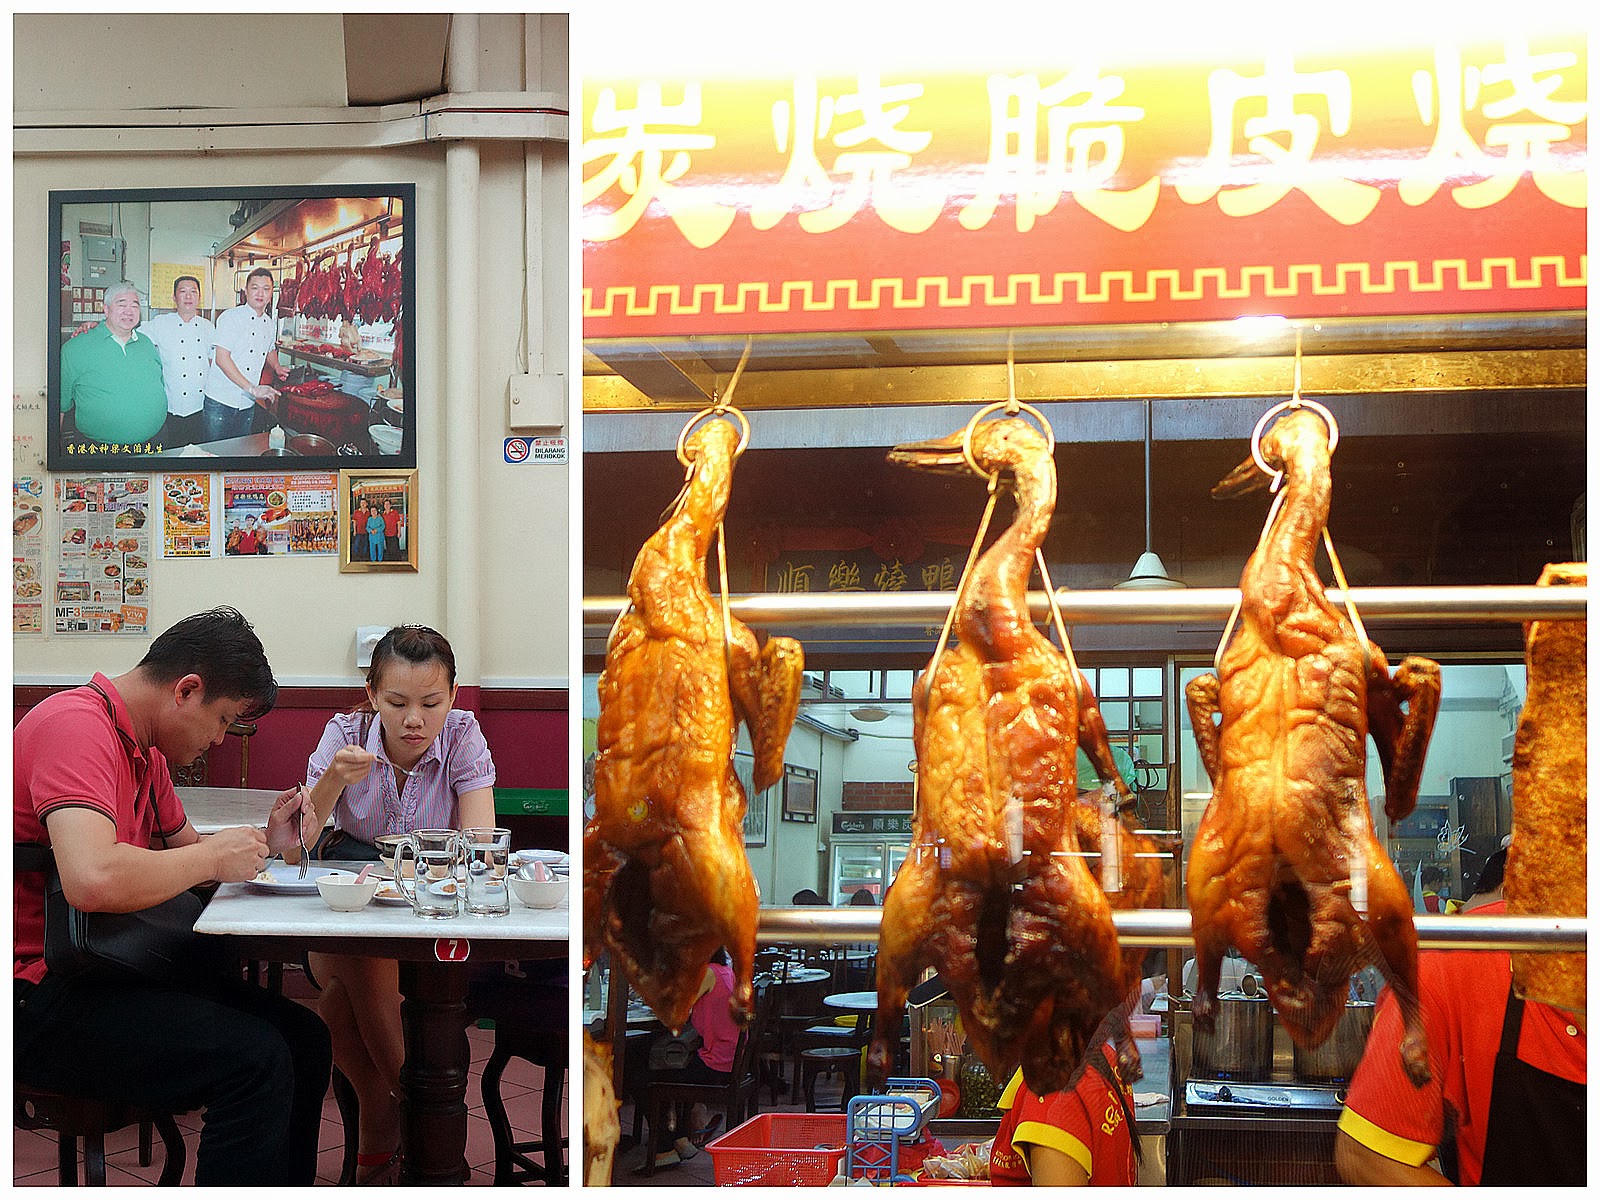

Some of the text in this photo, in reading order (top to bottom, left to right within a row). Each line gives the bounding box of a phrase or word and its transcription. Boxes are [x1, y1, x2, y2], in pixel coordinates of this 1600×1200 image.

[583, 36, 1588, 248] 炭烧脆皮烧
[55, 606, 81, 618] MF3
[126, 610, 144, 619] VIVA
[841, 821, 865, 831] Carlsberg
[449, 940, 458, 959] 7
